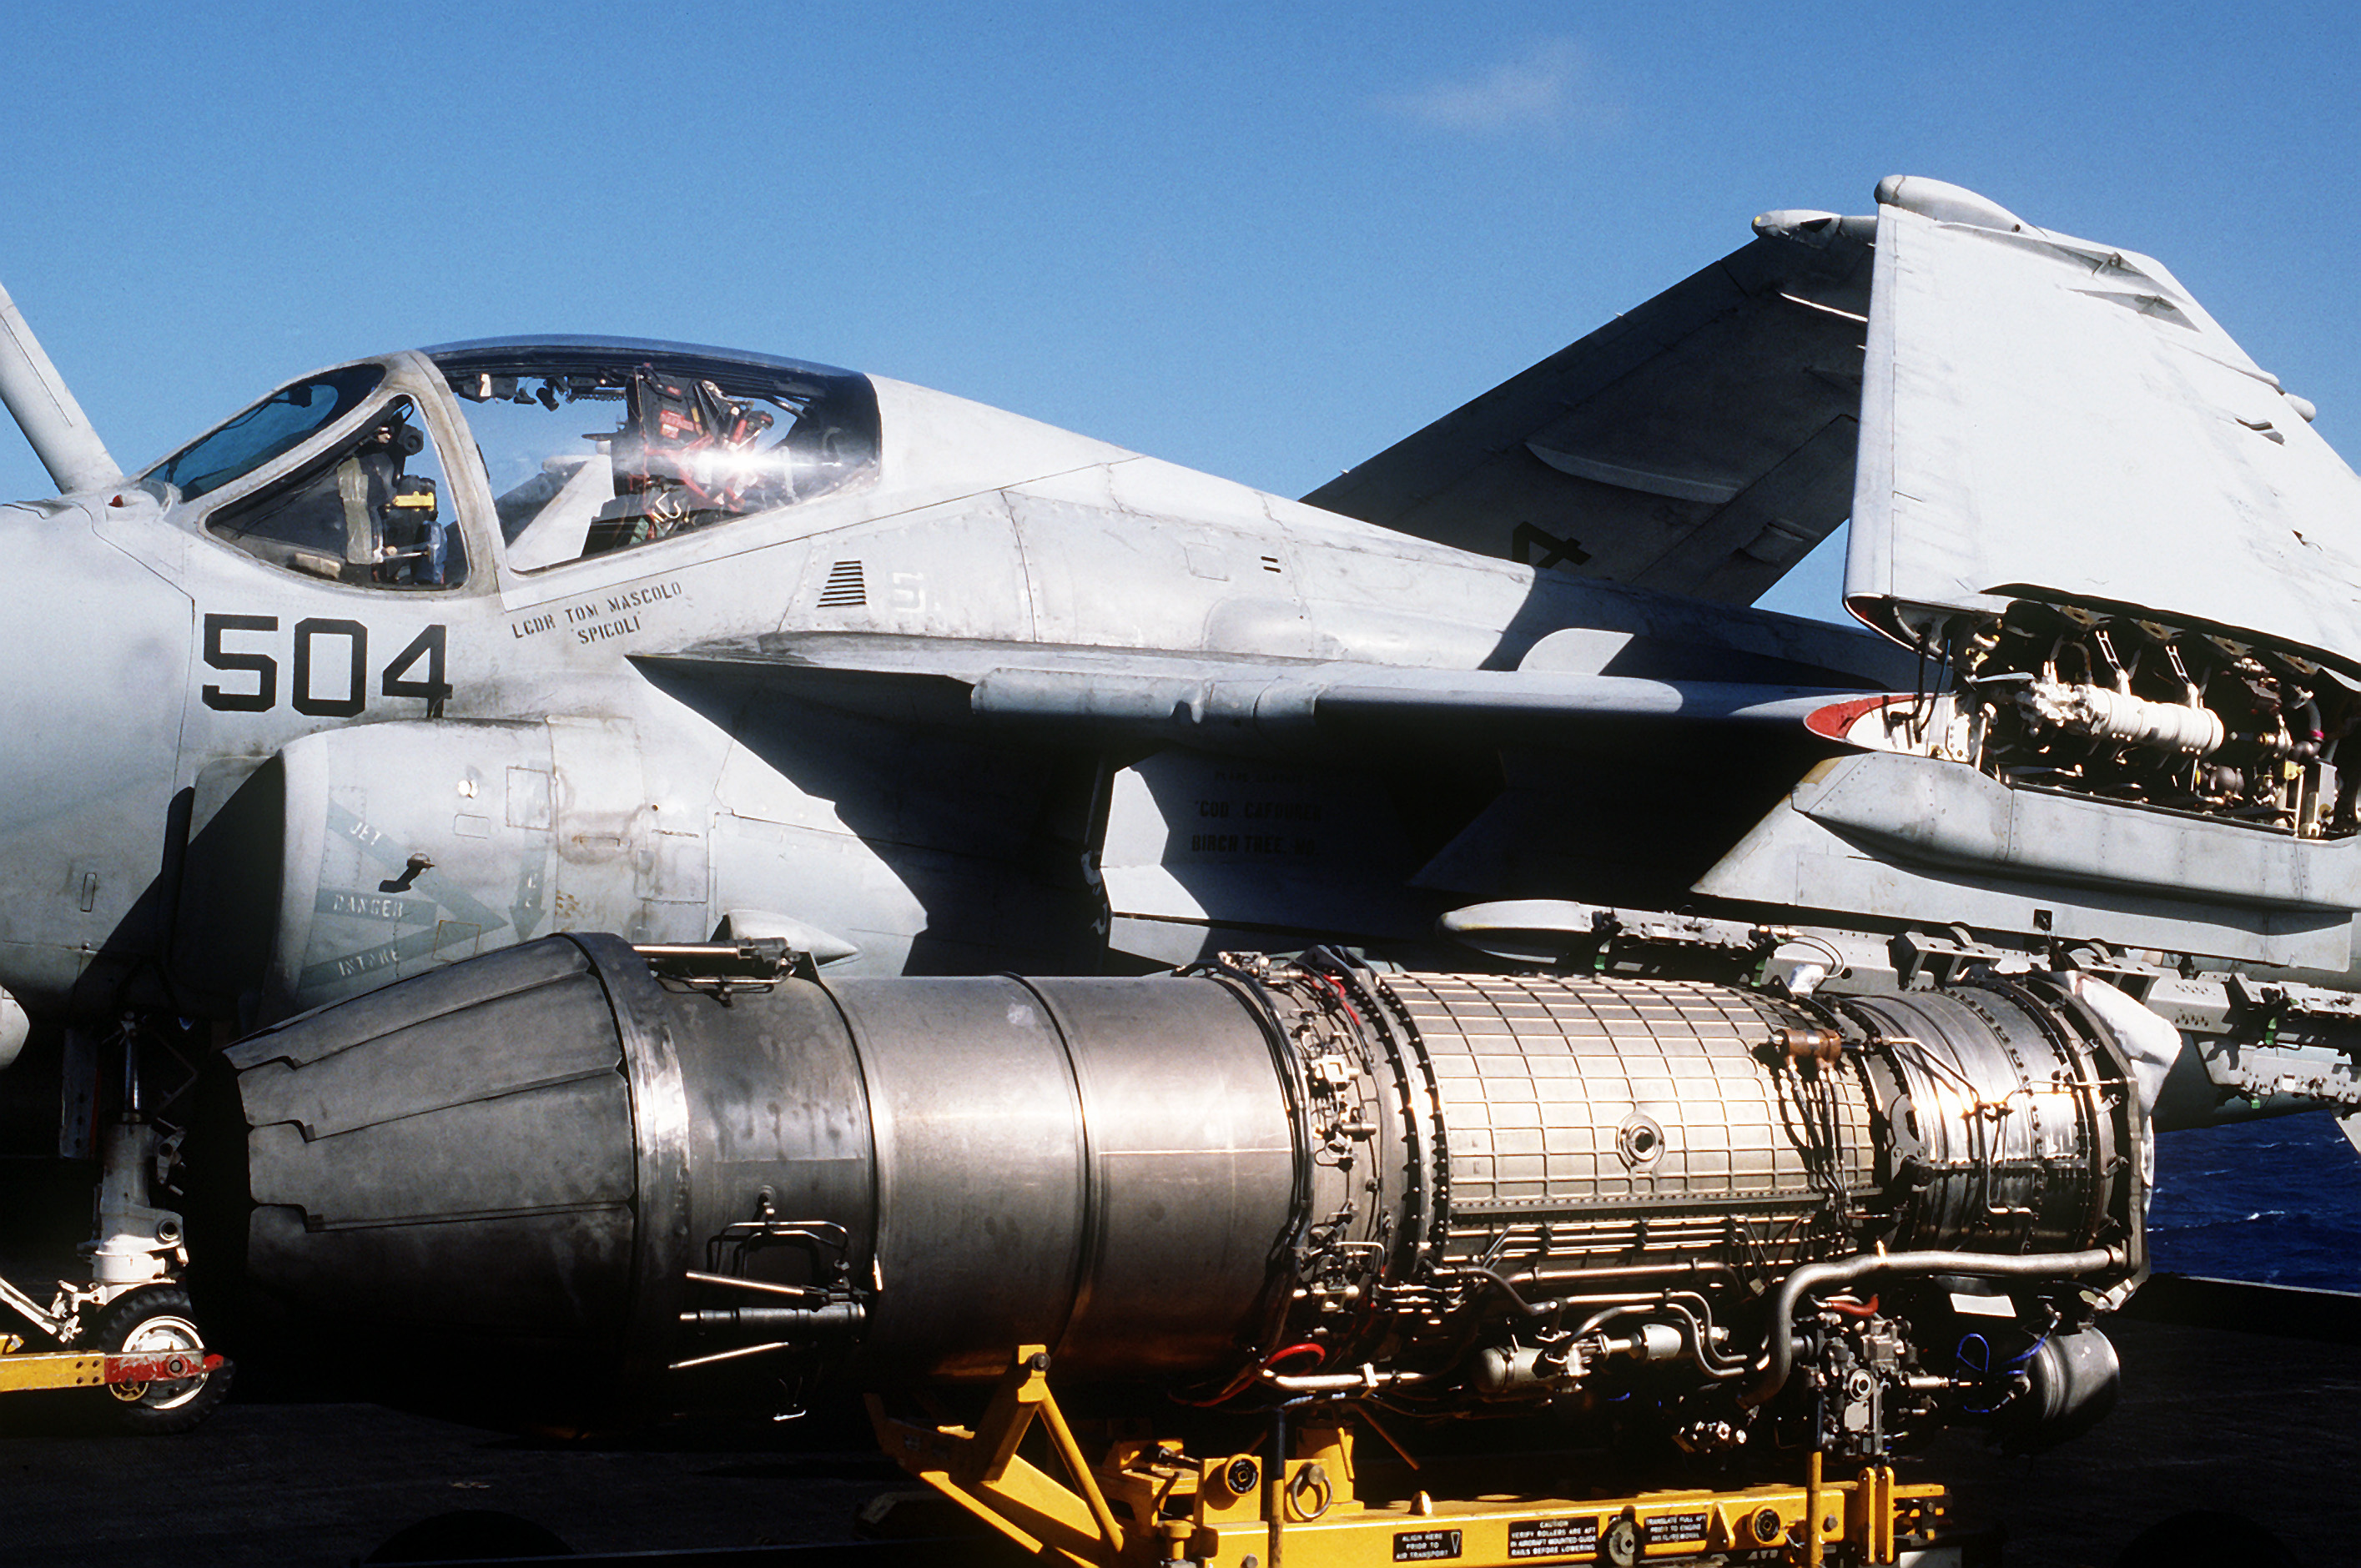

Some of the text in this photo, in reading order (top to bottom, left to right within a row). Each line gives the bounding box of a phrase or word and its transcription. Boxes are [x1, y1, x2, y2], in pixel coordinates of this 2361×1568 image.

[511, 580, 682, 640] LCDR TOM MASCOLO
[202, 613, 453, 718] 504
[350, 822, 382, 847] JET
[1191, 835, 1238, 852] BIRCH
[334, 893, 404, 917] DANGER
[337, 948, 400, 977] INTAKE
[1425, 1532, 1443, 1540] HERE
[1539, 1520, 1569, 1529] CAUTION
